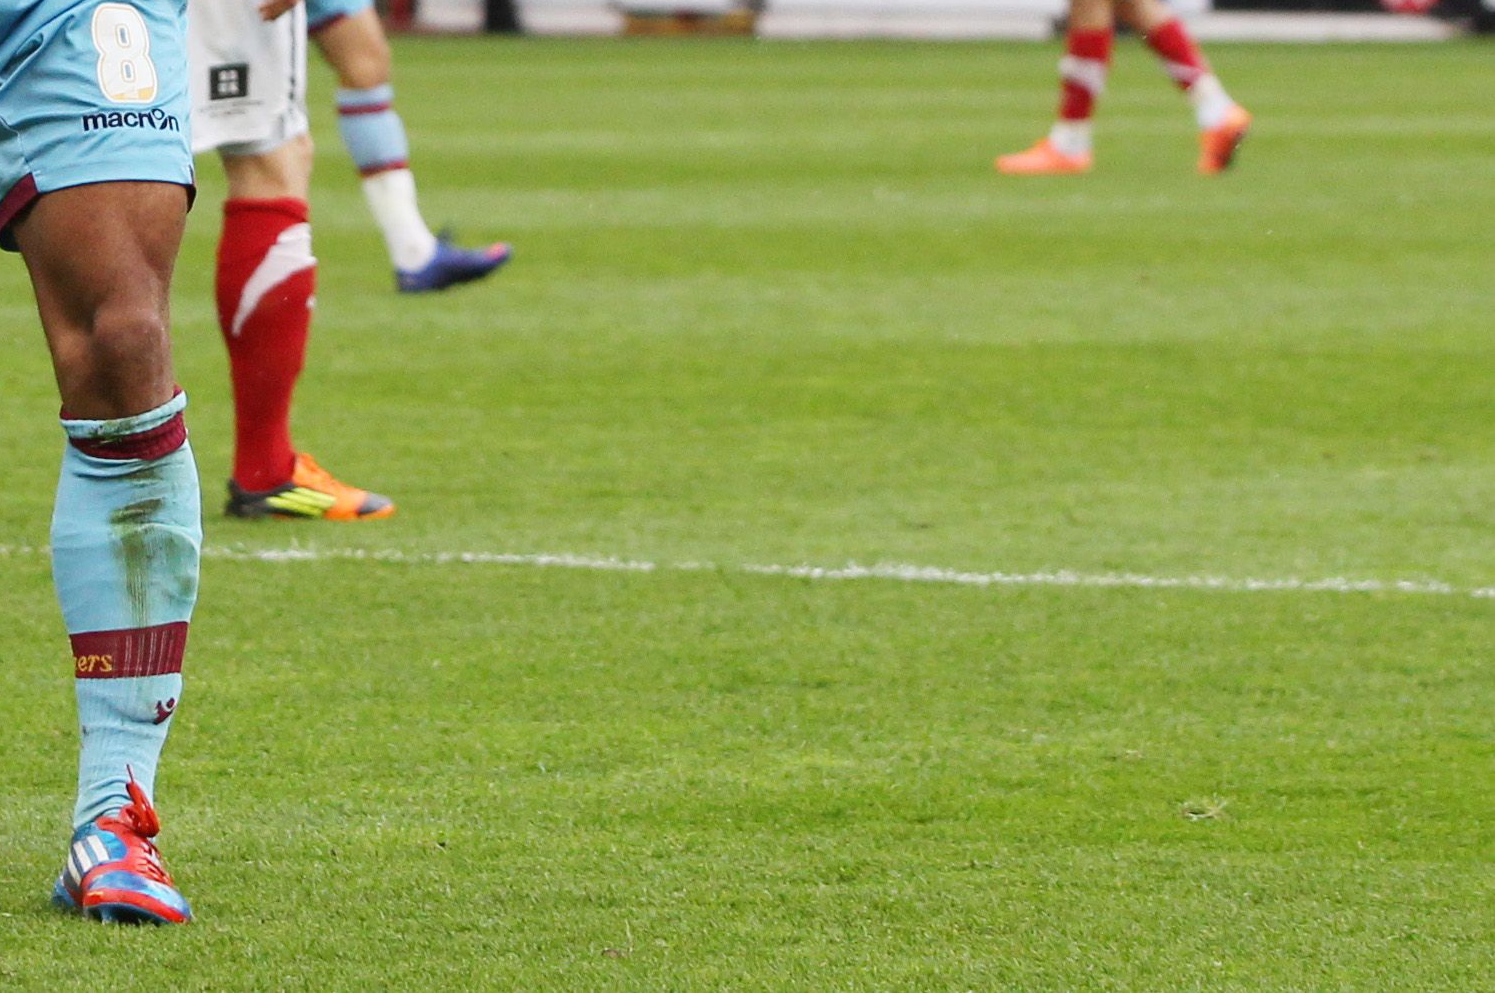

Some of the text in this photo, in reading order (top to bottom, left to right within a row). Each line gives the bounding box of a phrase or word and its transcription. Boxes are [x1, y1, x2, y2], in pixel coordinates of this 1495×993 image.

[91, 2, 157, 104] 8
[83, 108, 179, 132] macron
[74, 654, 113, 672] ers
